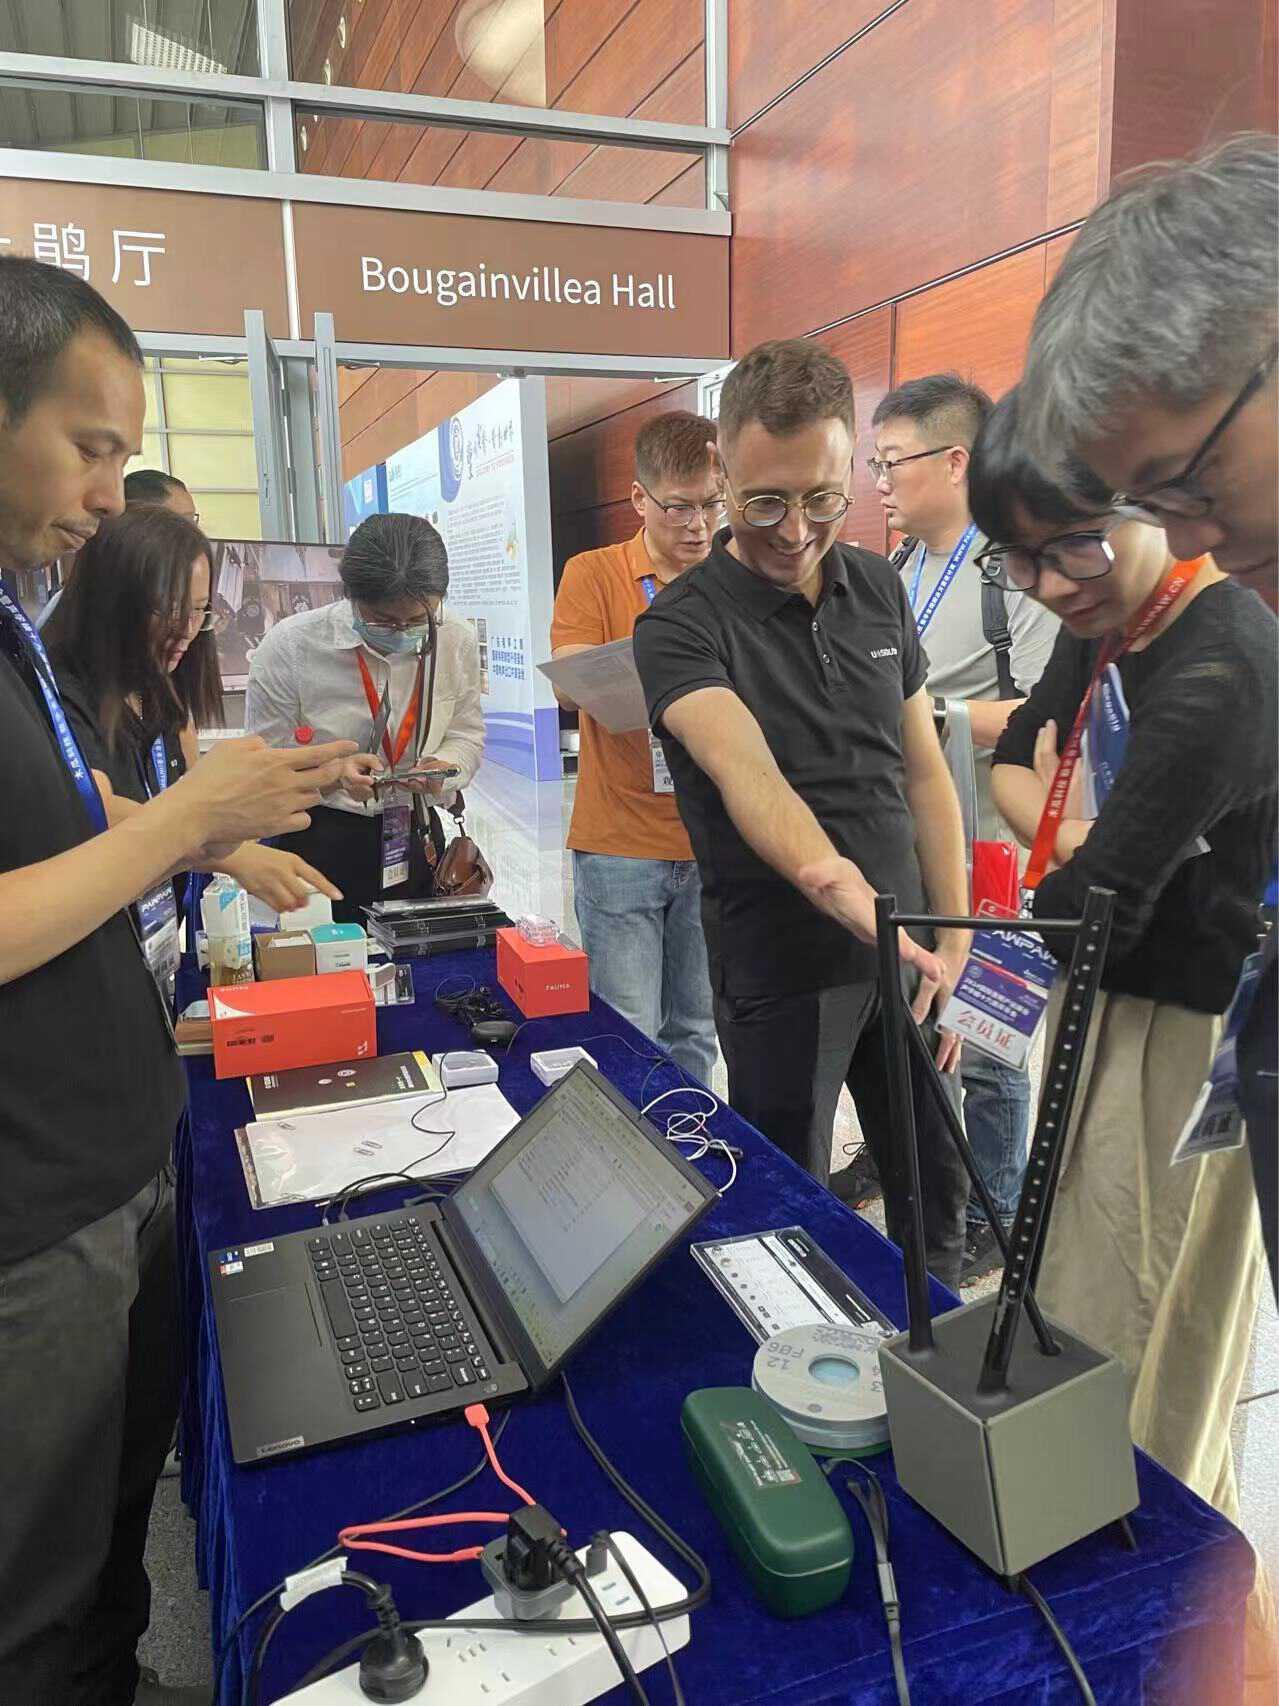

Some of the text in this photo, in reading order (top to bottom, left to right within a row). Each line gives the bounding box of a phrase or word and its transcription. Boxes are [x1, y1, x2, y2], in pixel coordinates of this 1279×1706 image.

[0, 222, 166, 287] 鹃厅
[361, 256, 676, 309] Bougainvillea Hall
